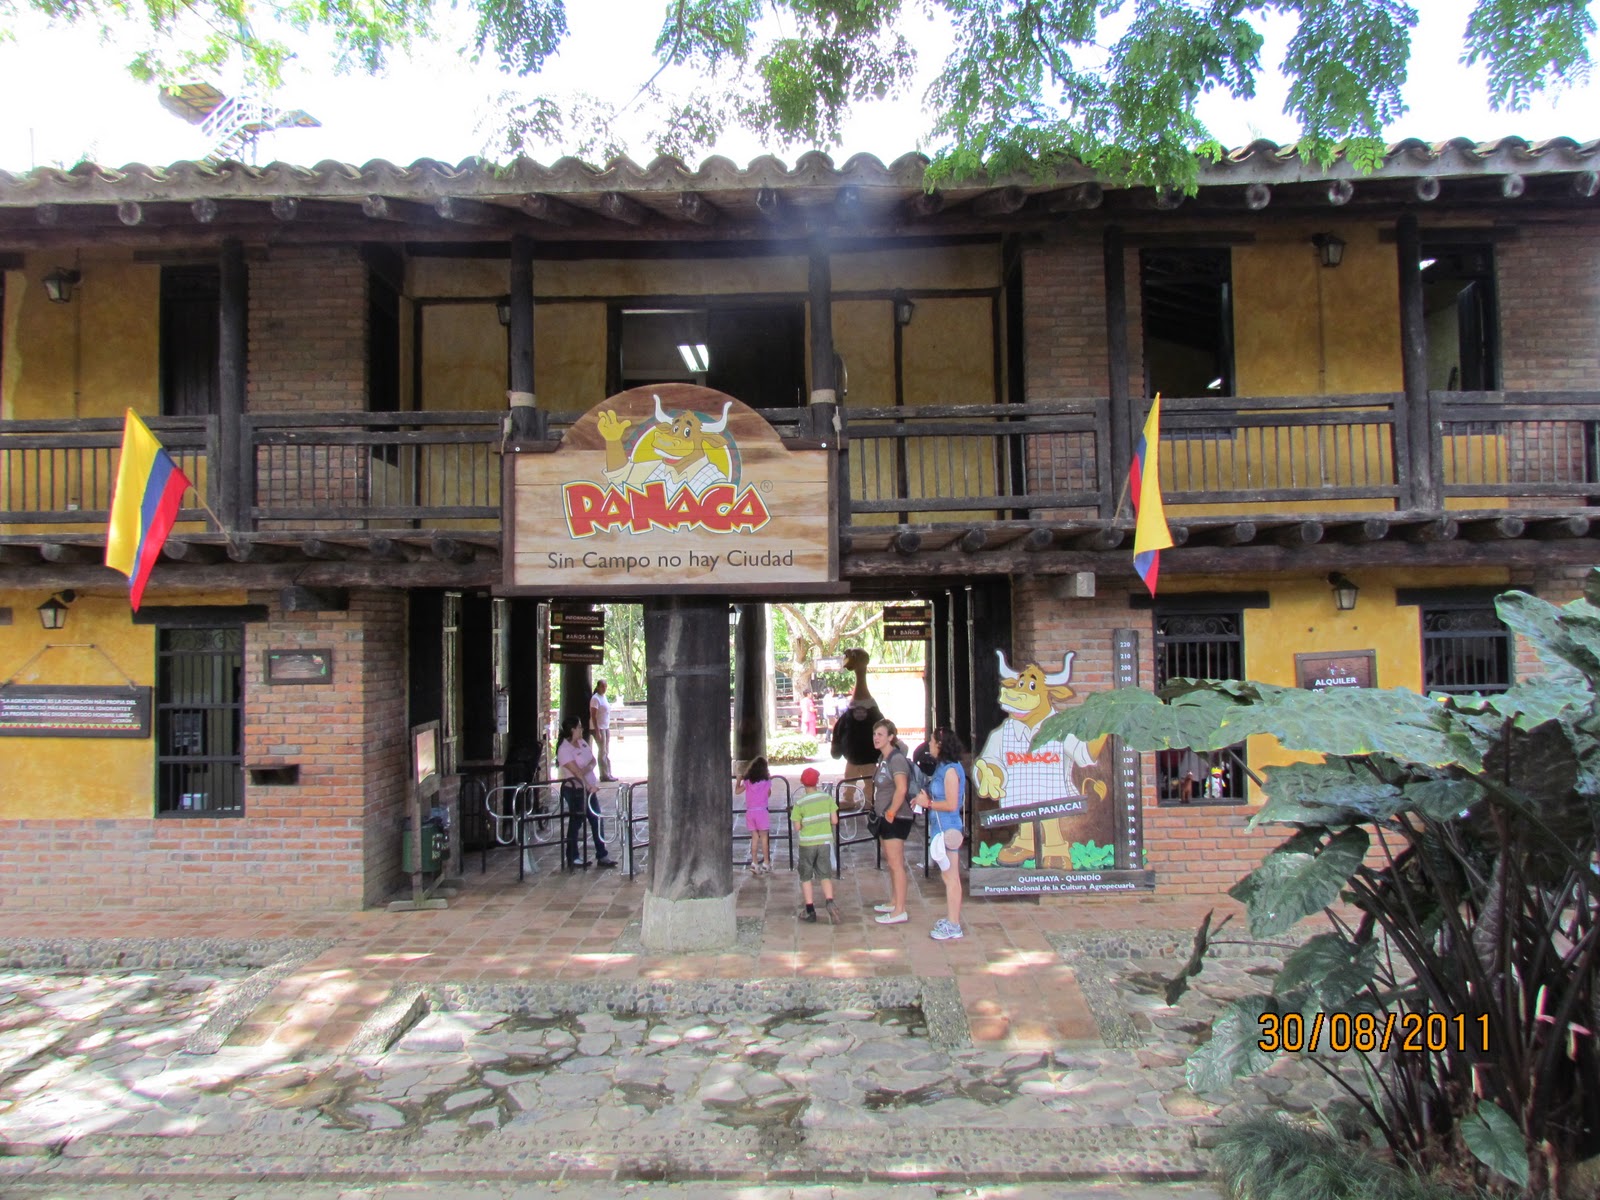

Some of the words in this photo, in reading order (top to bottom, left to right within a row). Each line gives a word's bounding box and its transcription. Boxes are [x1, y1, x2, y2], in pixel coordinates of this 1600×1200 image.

[561, 480, 771, 539] PANACA
[548, 552, 575, 569] Sin
[582, 552, 651, 573] Campo
[658, 554, 682, 568] no
[689, 550, 720, 572] hay
[726, 549, 794, 568] Ciudad
[1314, 677, 1357, 687] ALQUILER
[1005, 751, 1061, 767] PANACA
[1020, 810, 1037, 819] con
[1038, 801, 1083, 816] PANACA!
[1018, 875, 1060, 884] QUIMBAYA
[984, 885, 1009, 894] Parque
[1010, 884, 1041, 893] Nacional
[1042, 884, 1051, 892] de
[1052, 884, 1059, 892] la
[1060, 883, 1087, 892] Cultura
[1089, 882, 1136, 892] Agropecuaria
